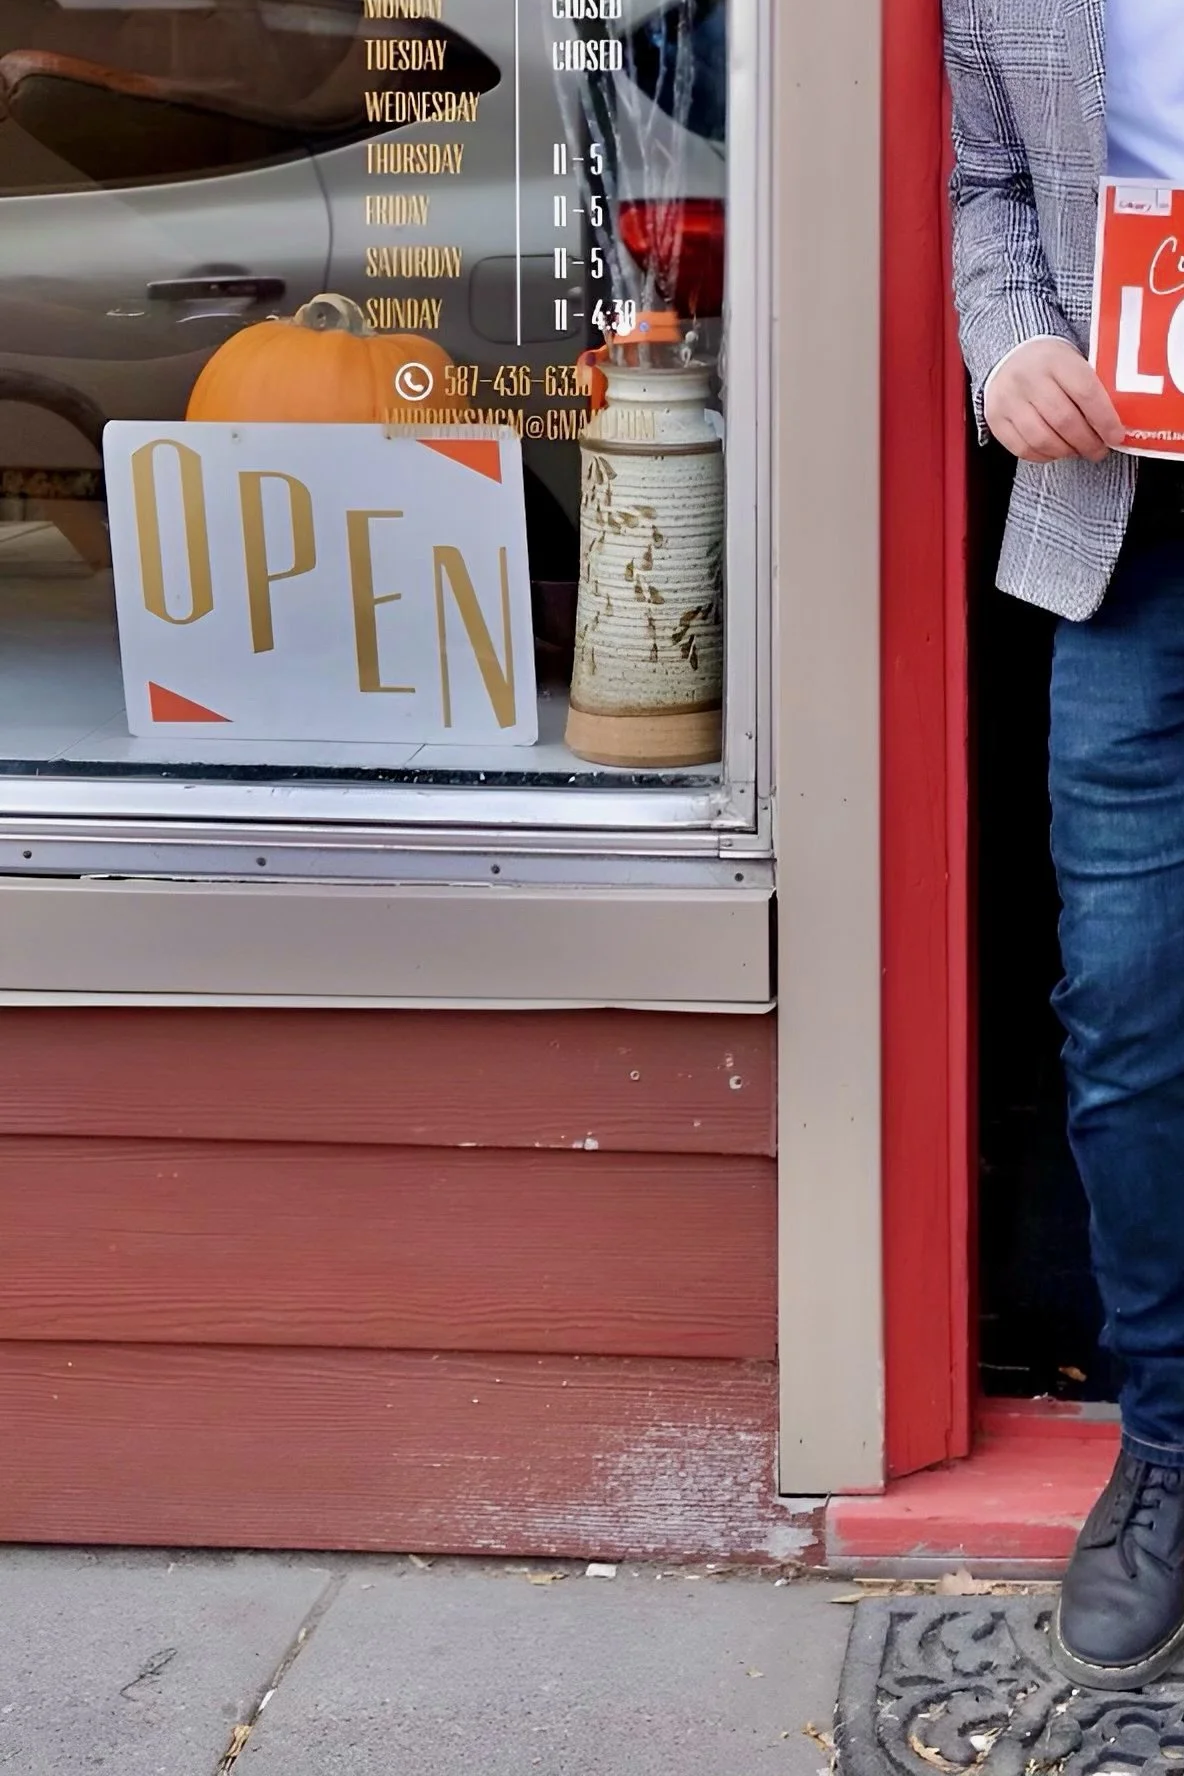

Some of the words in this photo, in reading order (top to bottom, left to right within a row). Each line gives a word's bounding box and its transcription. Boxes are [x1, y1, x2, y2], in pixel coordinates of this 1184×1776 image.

[365, 39, 447, 71] TUESDAY
[552, 39, 623, 71] CLOSED
[365, 91, 480, 123] WEDNESDAY
[367, 143, 464, 174] THURSDAY
[366, 195, 430, 227] FRIDAY
[366, 246, 462, 279] SATURDAY
[367, 298, 442, 330] SUNDAY
[131, 439, 517, 729] OPEN
